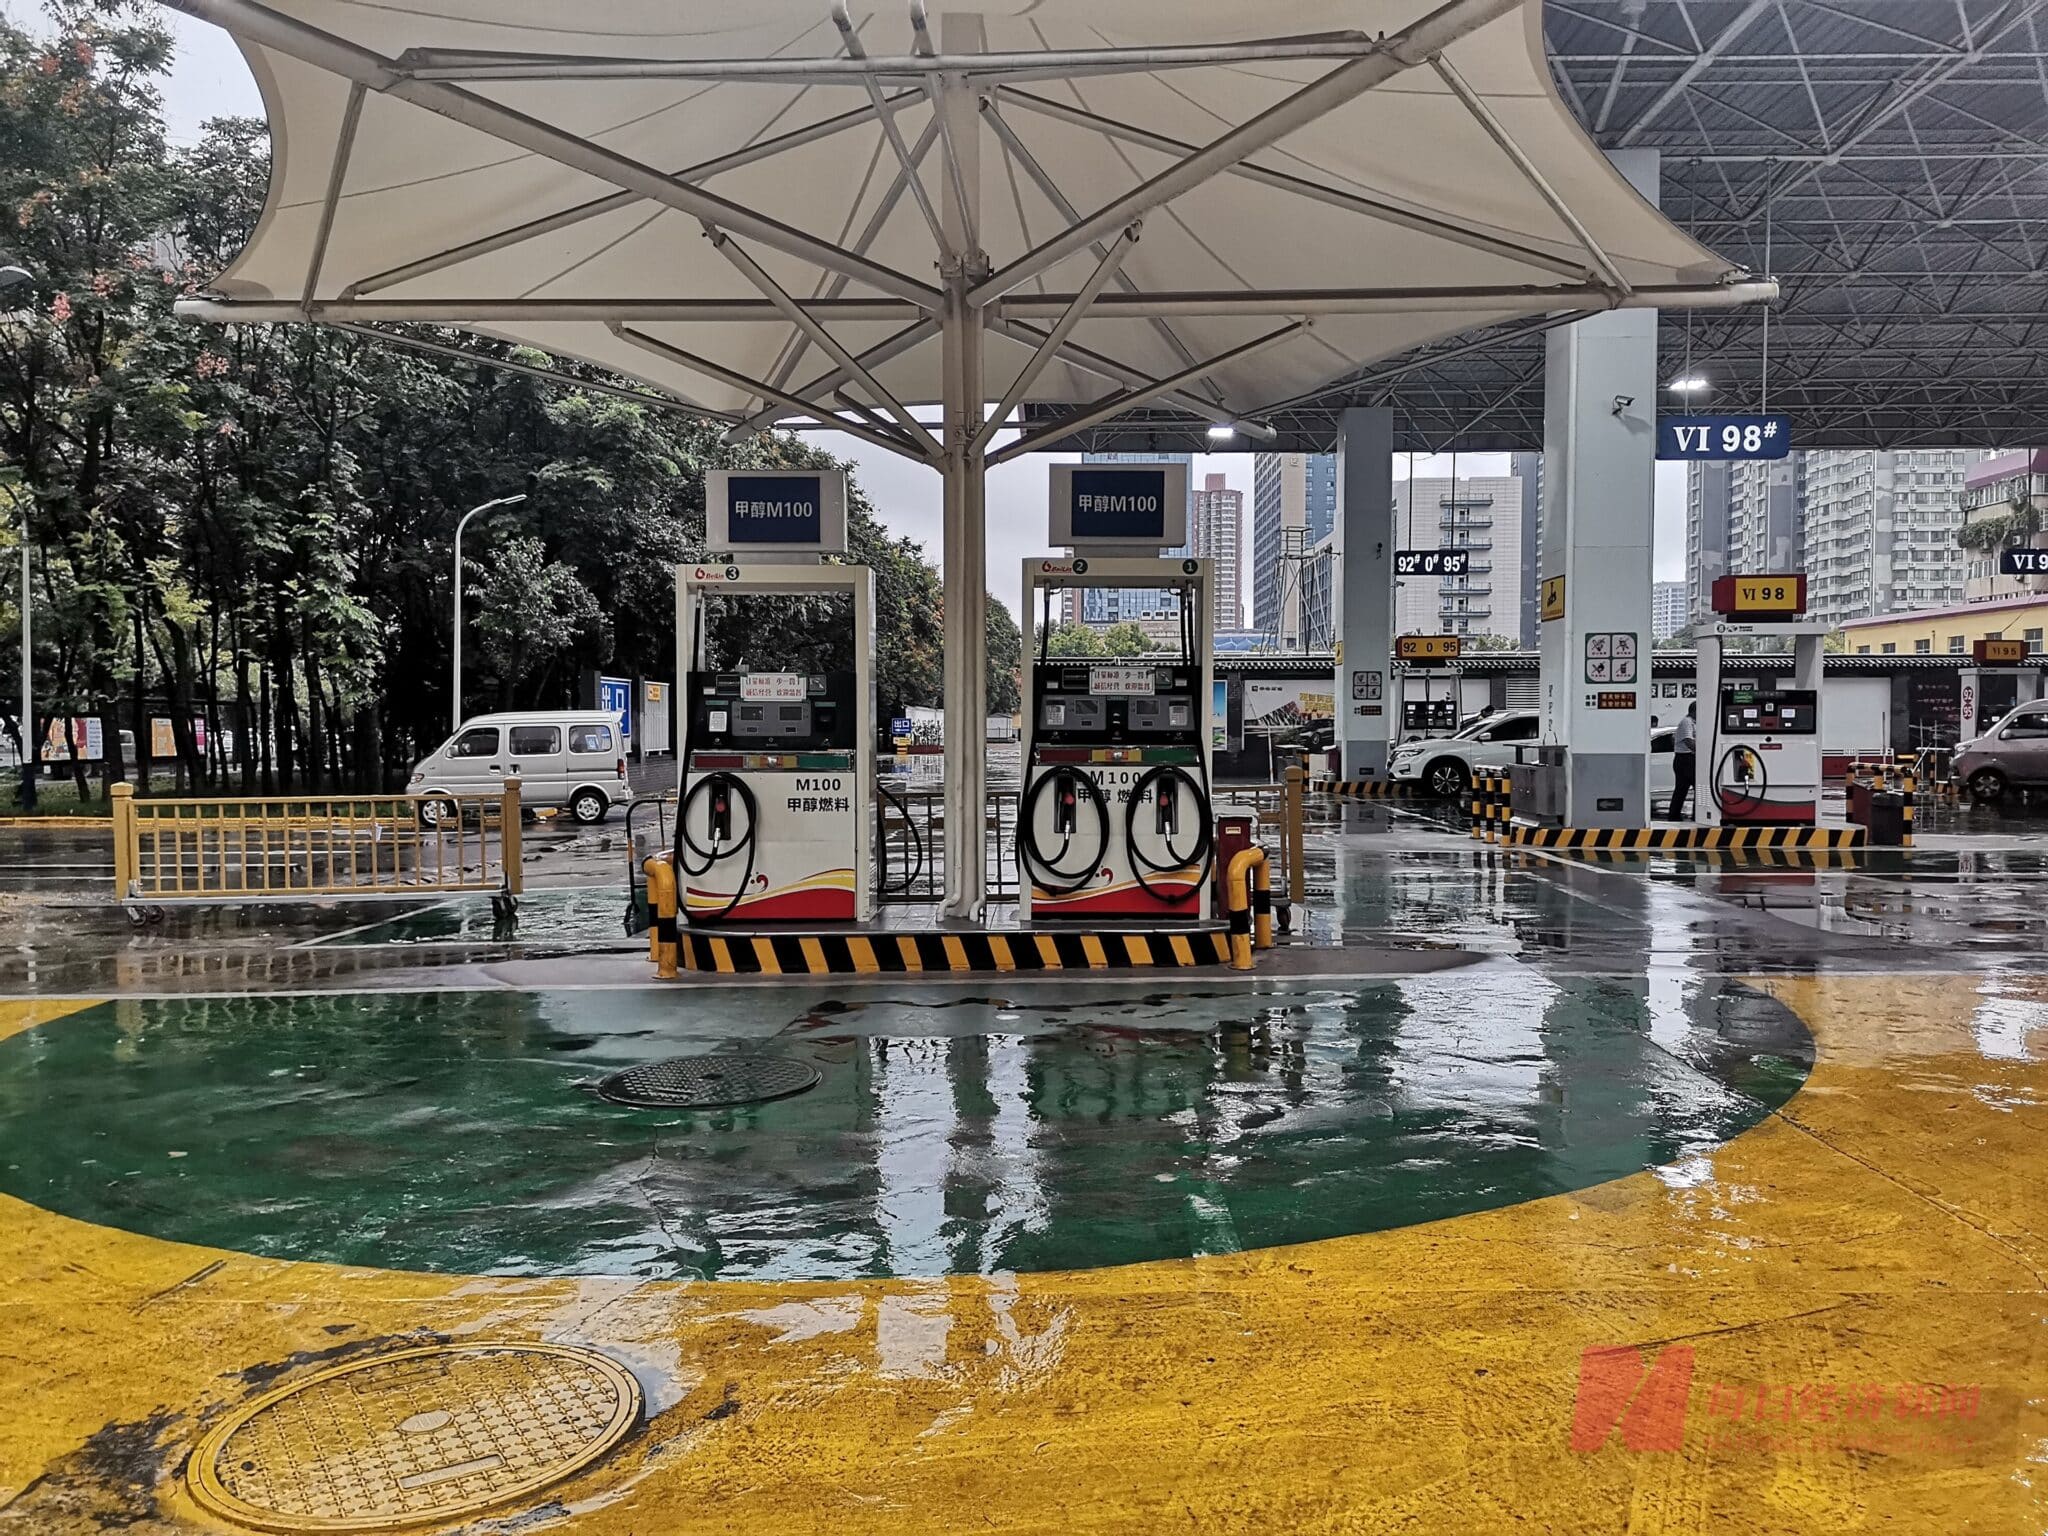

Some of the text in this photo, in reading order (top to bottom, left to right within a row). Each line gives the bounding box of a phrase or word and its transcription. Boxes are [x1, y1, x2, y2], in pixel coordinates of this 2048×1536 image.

[1673, 421, 1778, 452] VI 98#
[735, 500, 813, 519] 甲醇M100
[1078, 494, 1157, 513] 甲醇M100
[1398, 554, 1466, 572] 92# 0# 95#
[2012, 554, 2035, 570] VI
[728, 567, 737, 579] 3
[1742, 588, 1785, 600] VI 98
[1403, 642, 1456, 653] 92 0 95
[601, 685, 625, 711] 出口
[894, 720, 910, 728] 出口
[796, 778, 842, 791] M100
[1090, 771, 1141, 785] M100
[1077, 789, 1153, 804] 甲醇燃料
[787, 797, 850, 812] 甲醇燃料
